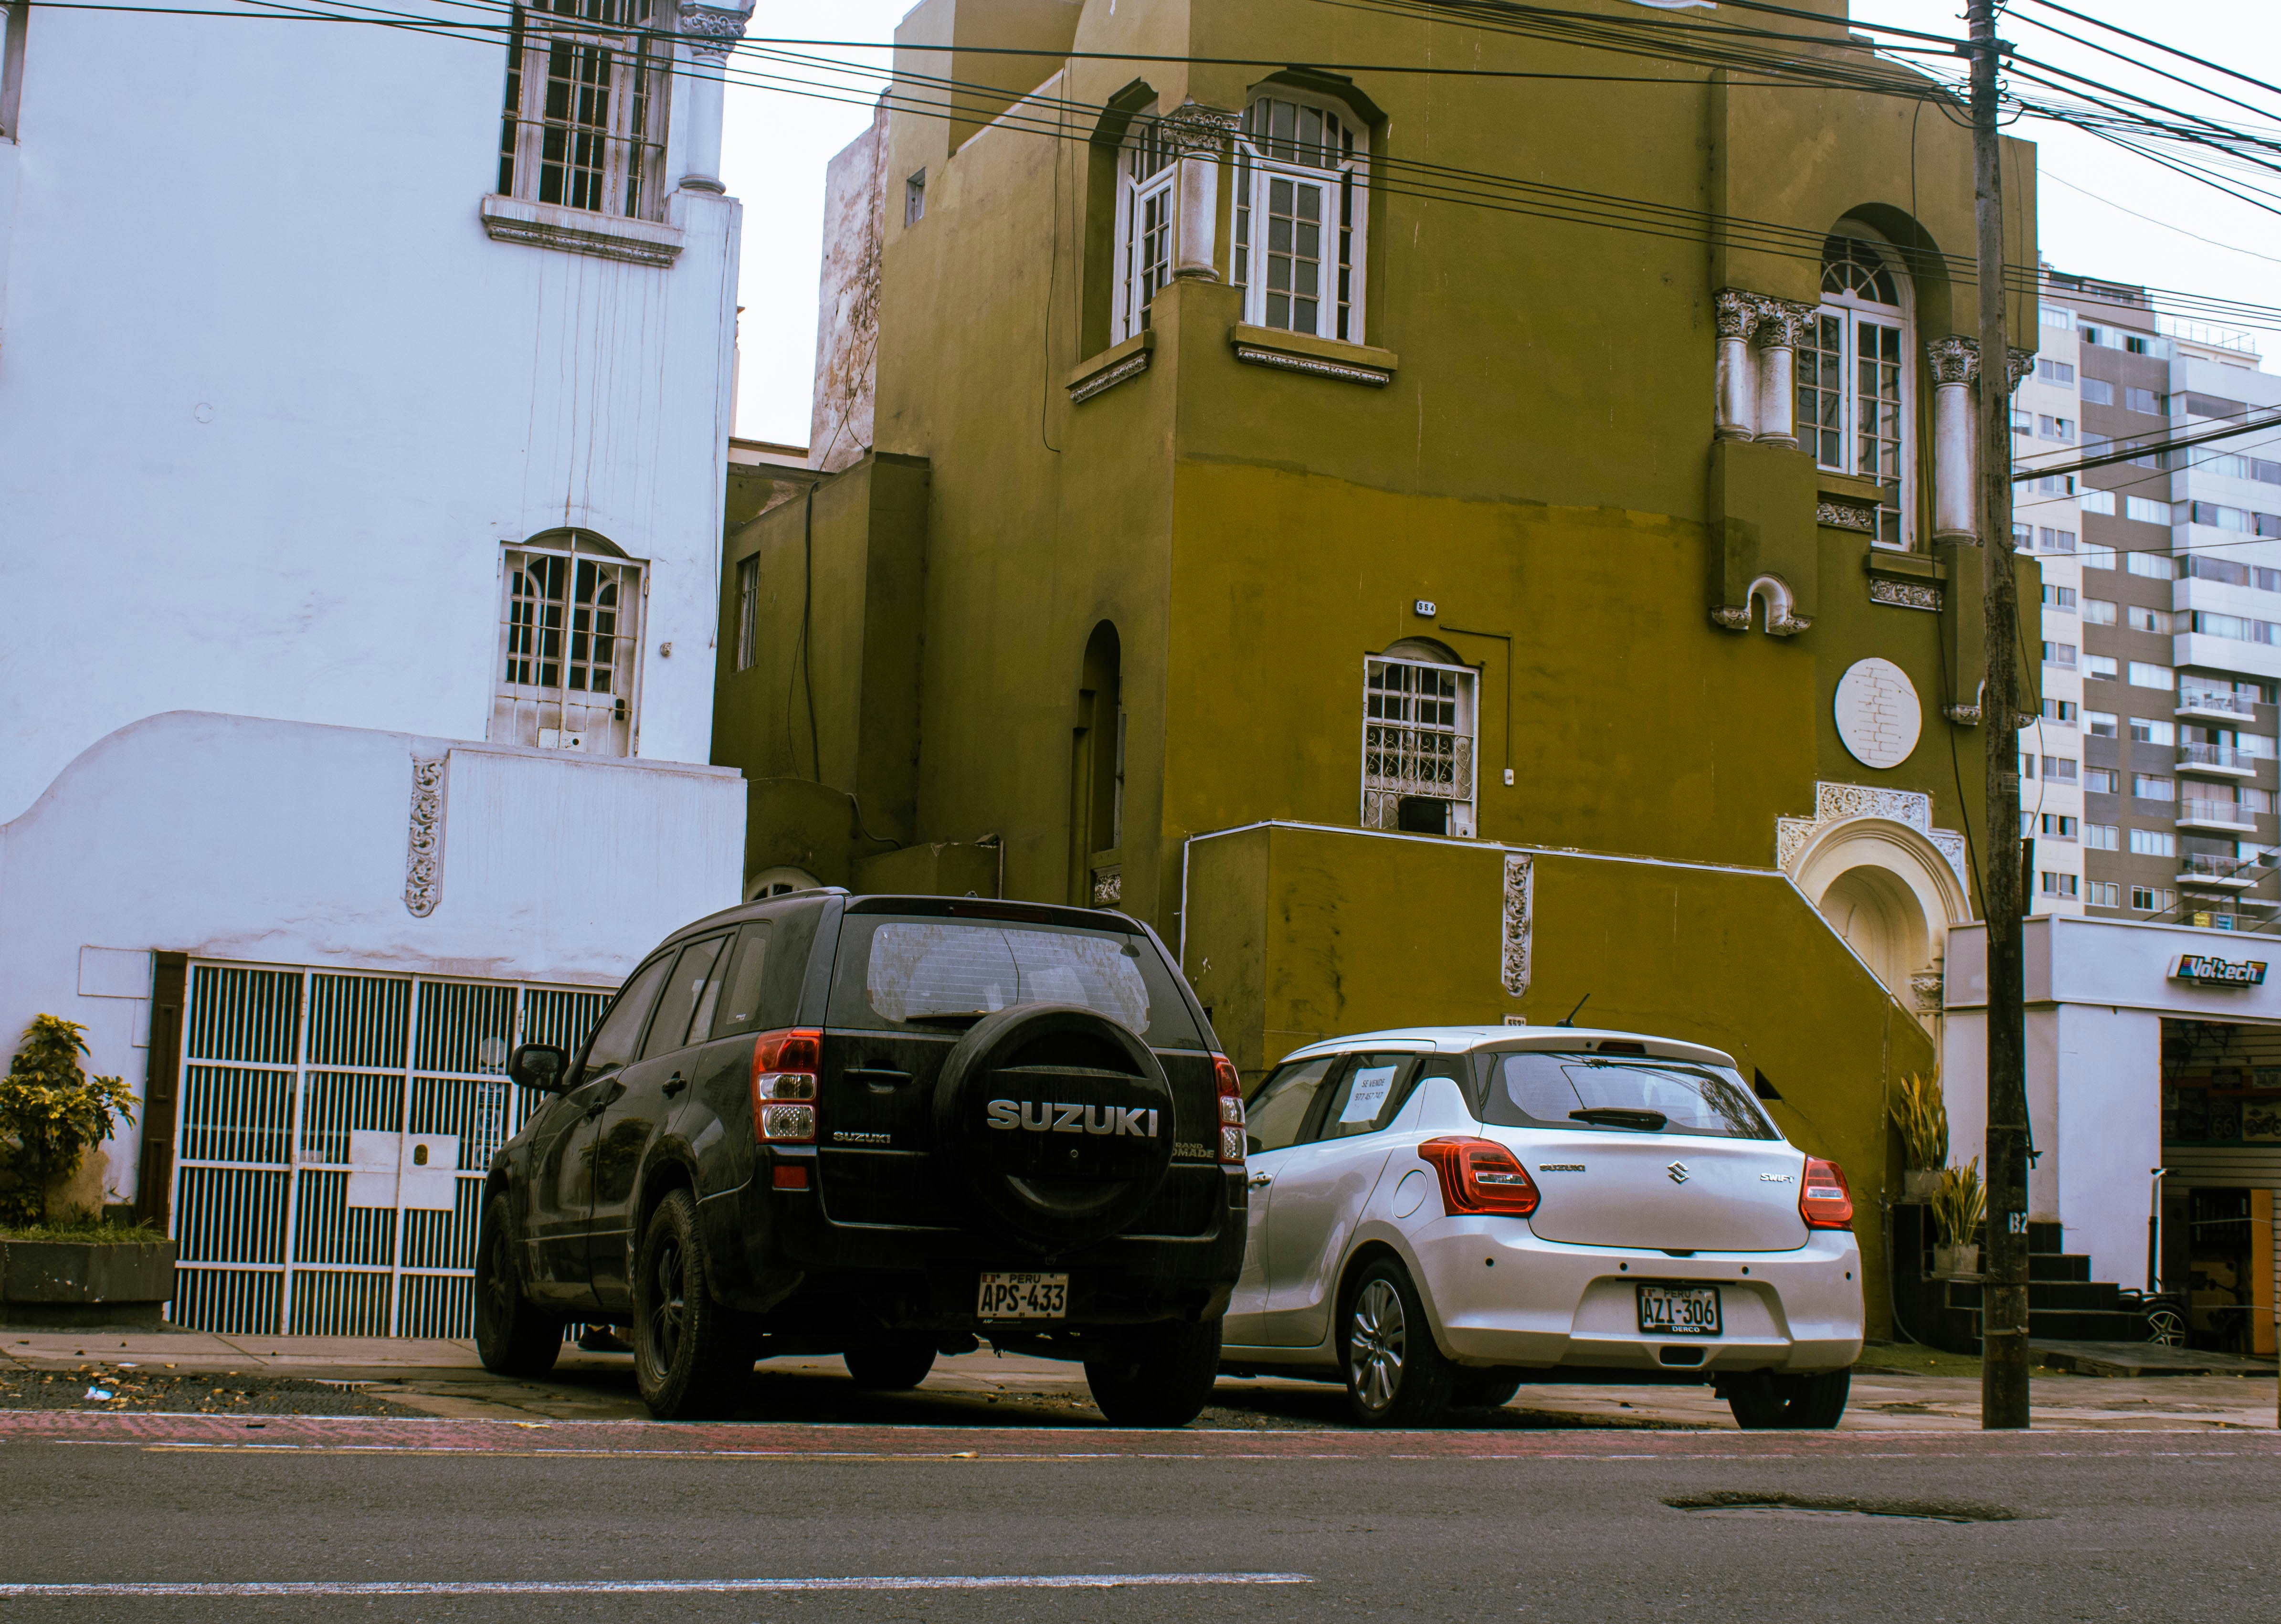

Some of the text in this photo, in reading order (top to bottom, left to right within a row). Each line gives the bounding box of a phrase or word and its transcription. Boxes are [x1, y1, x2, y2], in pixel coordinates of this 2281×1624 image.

[1419, 602, 1434, 612] 554
[2191, 957, 2257, 981] Voltech
[1362, 1078, 1385, 1087] SE VENDE
[987, 1100, 1158, 1138] SUZUKI
[833, 1131, 891, 1144] SUZUKI
[1172, 1148, 1214, 1158] OMADE
[1539, 1164, 1585, 1172] SUZUKI
[1760, 1173, 1794, 1183] SWIFT
[1009, 1274, 1041, 1284] PERU
[981, 1284, 1065, 1312] APS-433
[1664, 1290, 1691, 1298] PERU
[1644, 1297, 1715, 1325] AZI-306
